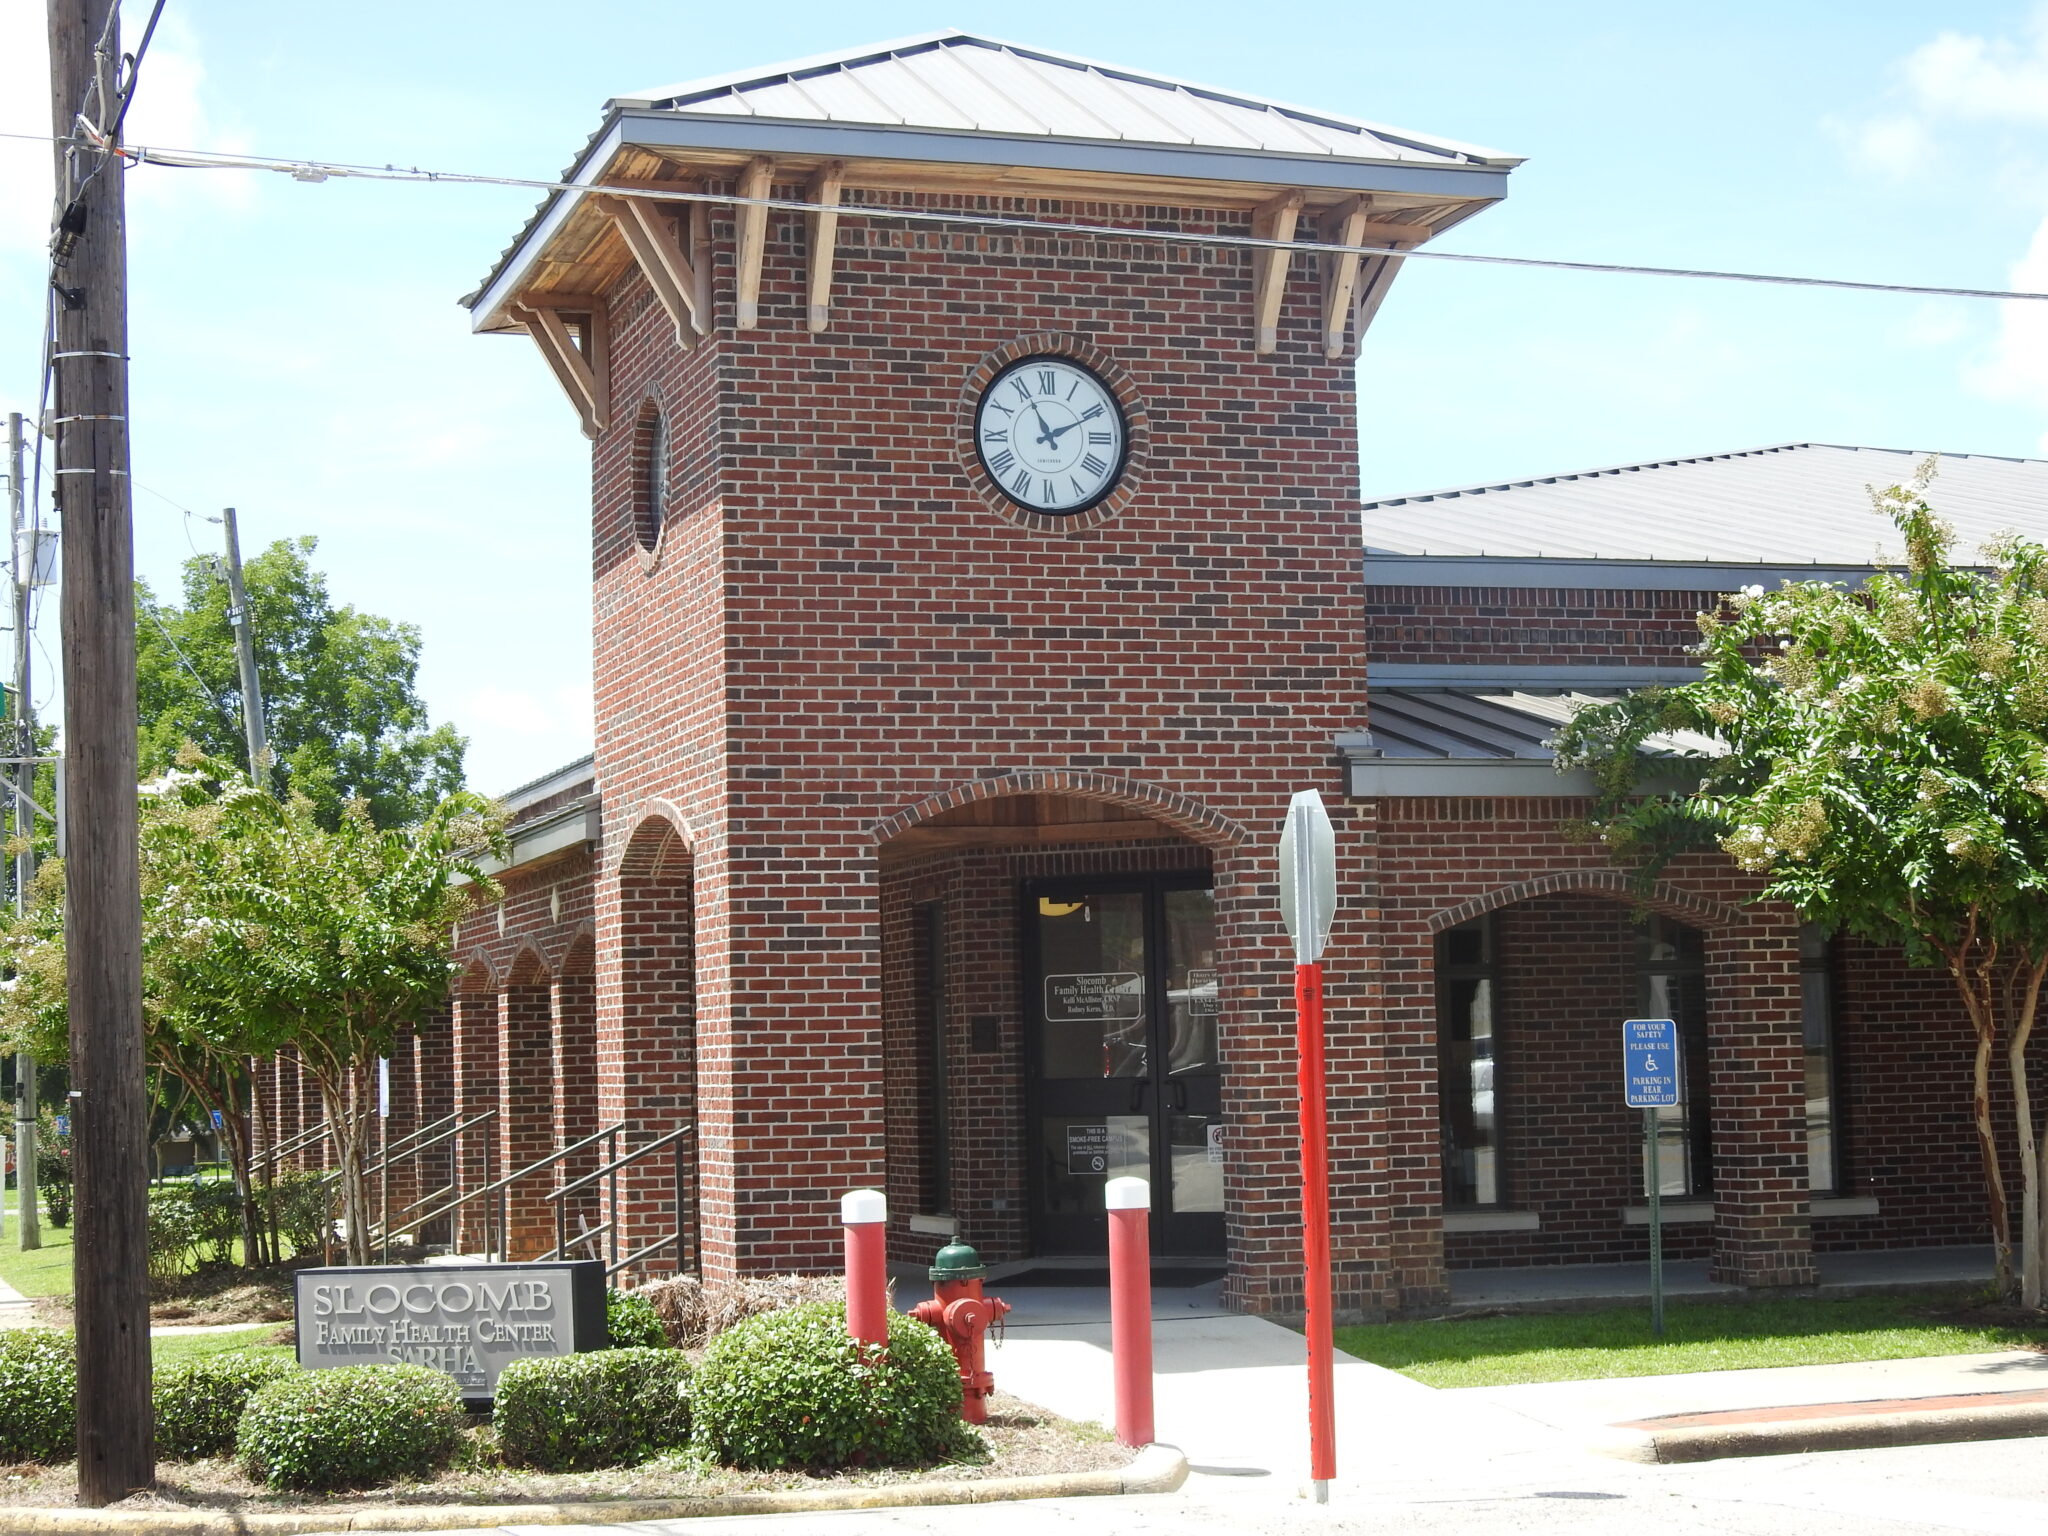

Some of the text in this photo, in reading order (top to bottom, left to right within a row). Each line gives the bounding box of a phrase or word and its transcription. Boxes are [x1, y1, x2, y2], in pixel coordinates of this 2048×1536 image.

[1009, 376, 1033, 403] XI
[1037, 371, 1056, 395] XII
[1066, 380, 1080, 402] I
[990, 398, 1014, 419] X
[984, 428, 1008, 443] IX
[1088, 432, 1111, 445] III
[989, 448, 1016, 478] VIII
[1080, 452, 1107, 479] IIII
[1010, 469, 1032, 498] VII
[1043, 479, 1056, 503] VI
[1069, 474, 1085, 497] V
[1054, 986, 1079, 996] Family
[1080, 985, 1104, 994] Health
[1076, 976, 1106, 986] Slocomb
[1647, 1023, 1666, 1031] YOUR
[1630, 1042, 1670, 1051] PLEASE USE
[1632, 1076, 1671, 1085] PARKING IN
[1630, 1094, 1675, 1103] PARKING LOT
[313, 1281, 552, 1315] SLOCOMB
[387, 1345, 485, 1373] SARHA
